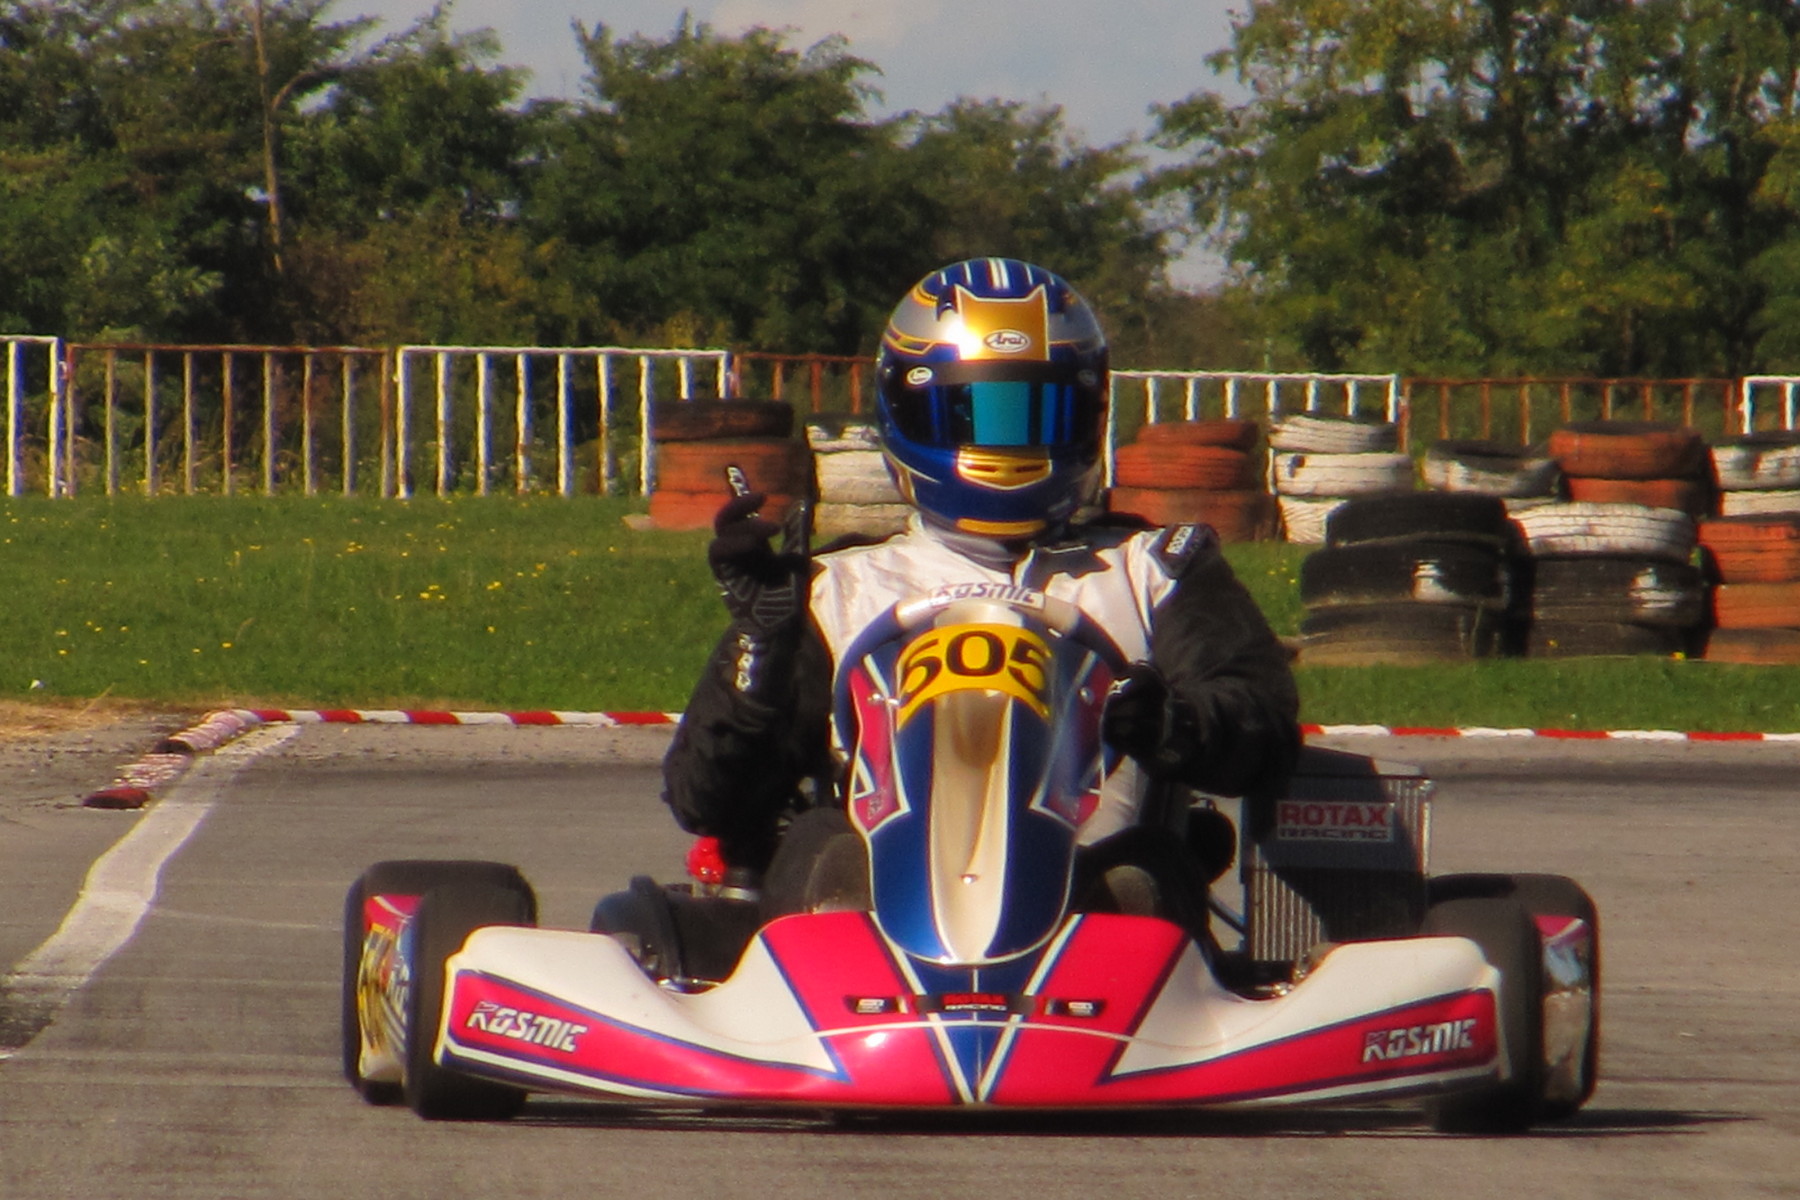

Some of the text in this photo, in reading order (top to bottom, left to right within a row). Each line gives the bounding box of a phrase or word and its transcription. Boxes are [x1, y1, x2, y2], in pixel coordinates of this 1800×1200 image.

[1280, 803, 1387, 826] ROTAX
[466, 1001, 588, 1053] KOSMIC
[1362, 1018, 1477, 1063] KOSMIC
